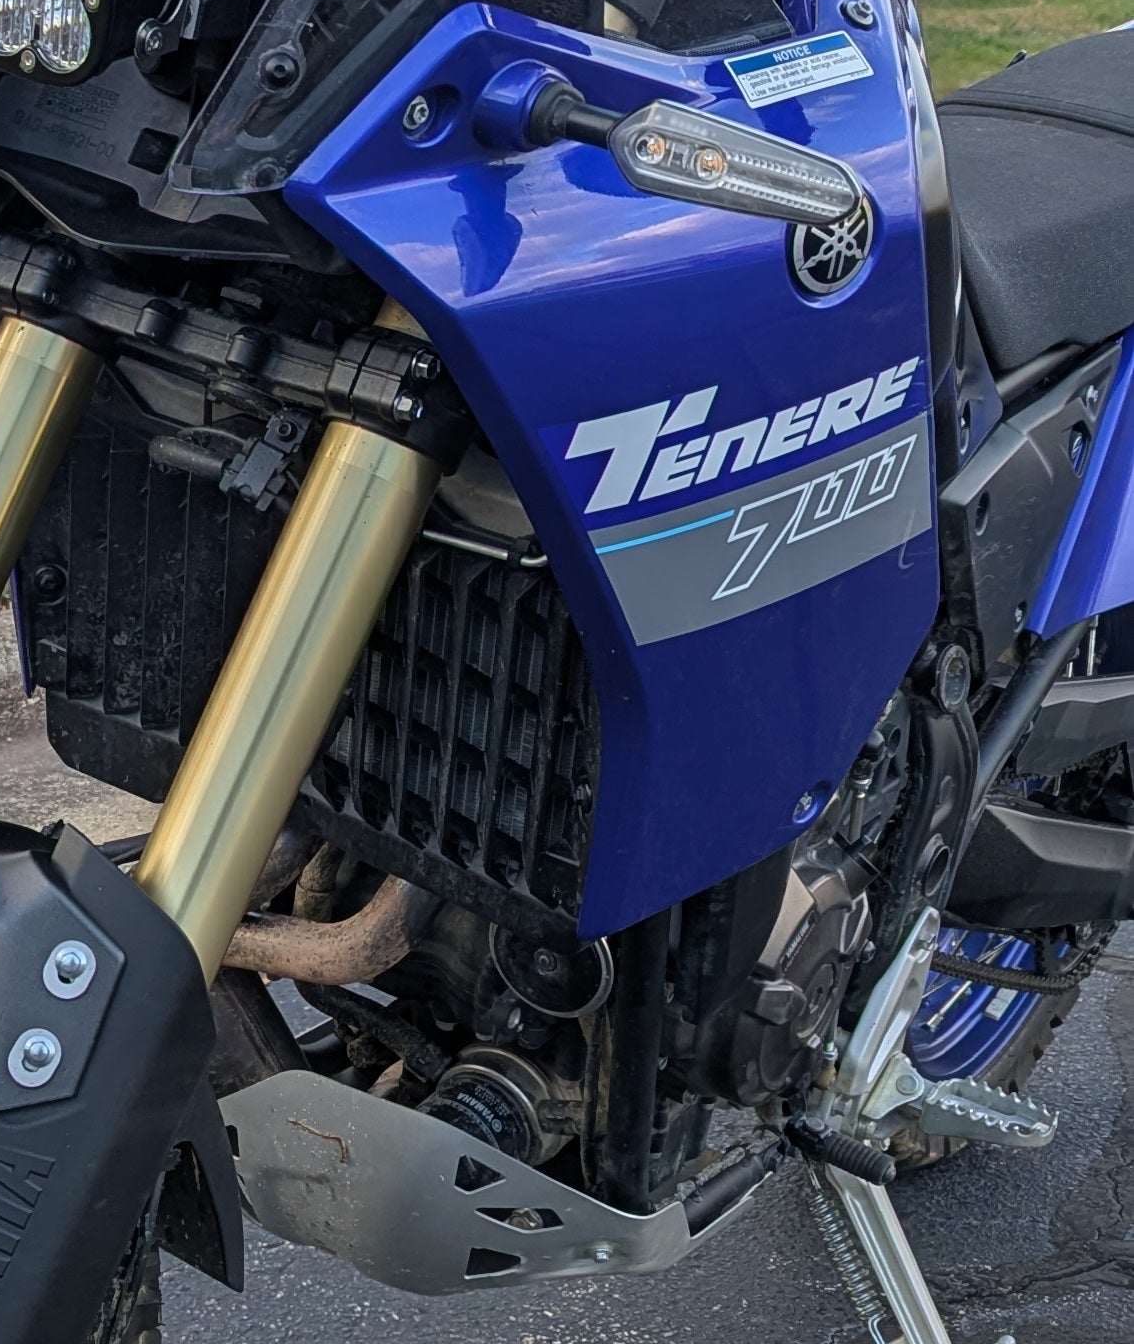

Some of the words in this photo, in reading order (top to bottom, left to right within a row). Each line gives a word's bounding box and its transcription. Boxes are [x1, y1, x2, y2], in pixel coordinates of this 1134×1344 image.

[772, 44, 812, 63] NOTICE
[711, 434, 917, 601] 700
[456, 1092, 495, 1123] YAMAHA
